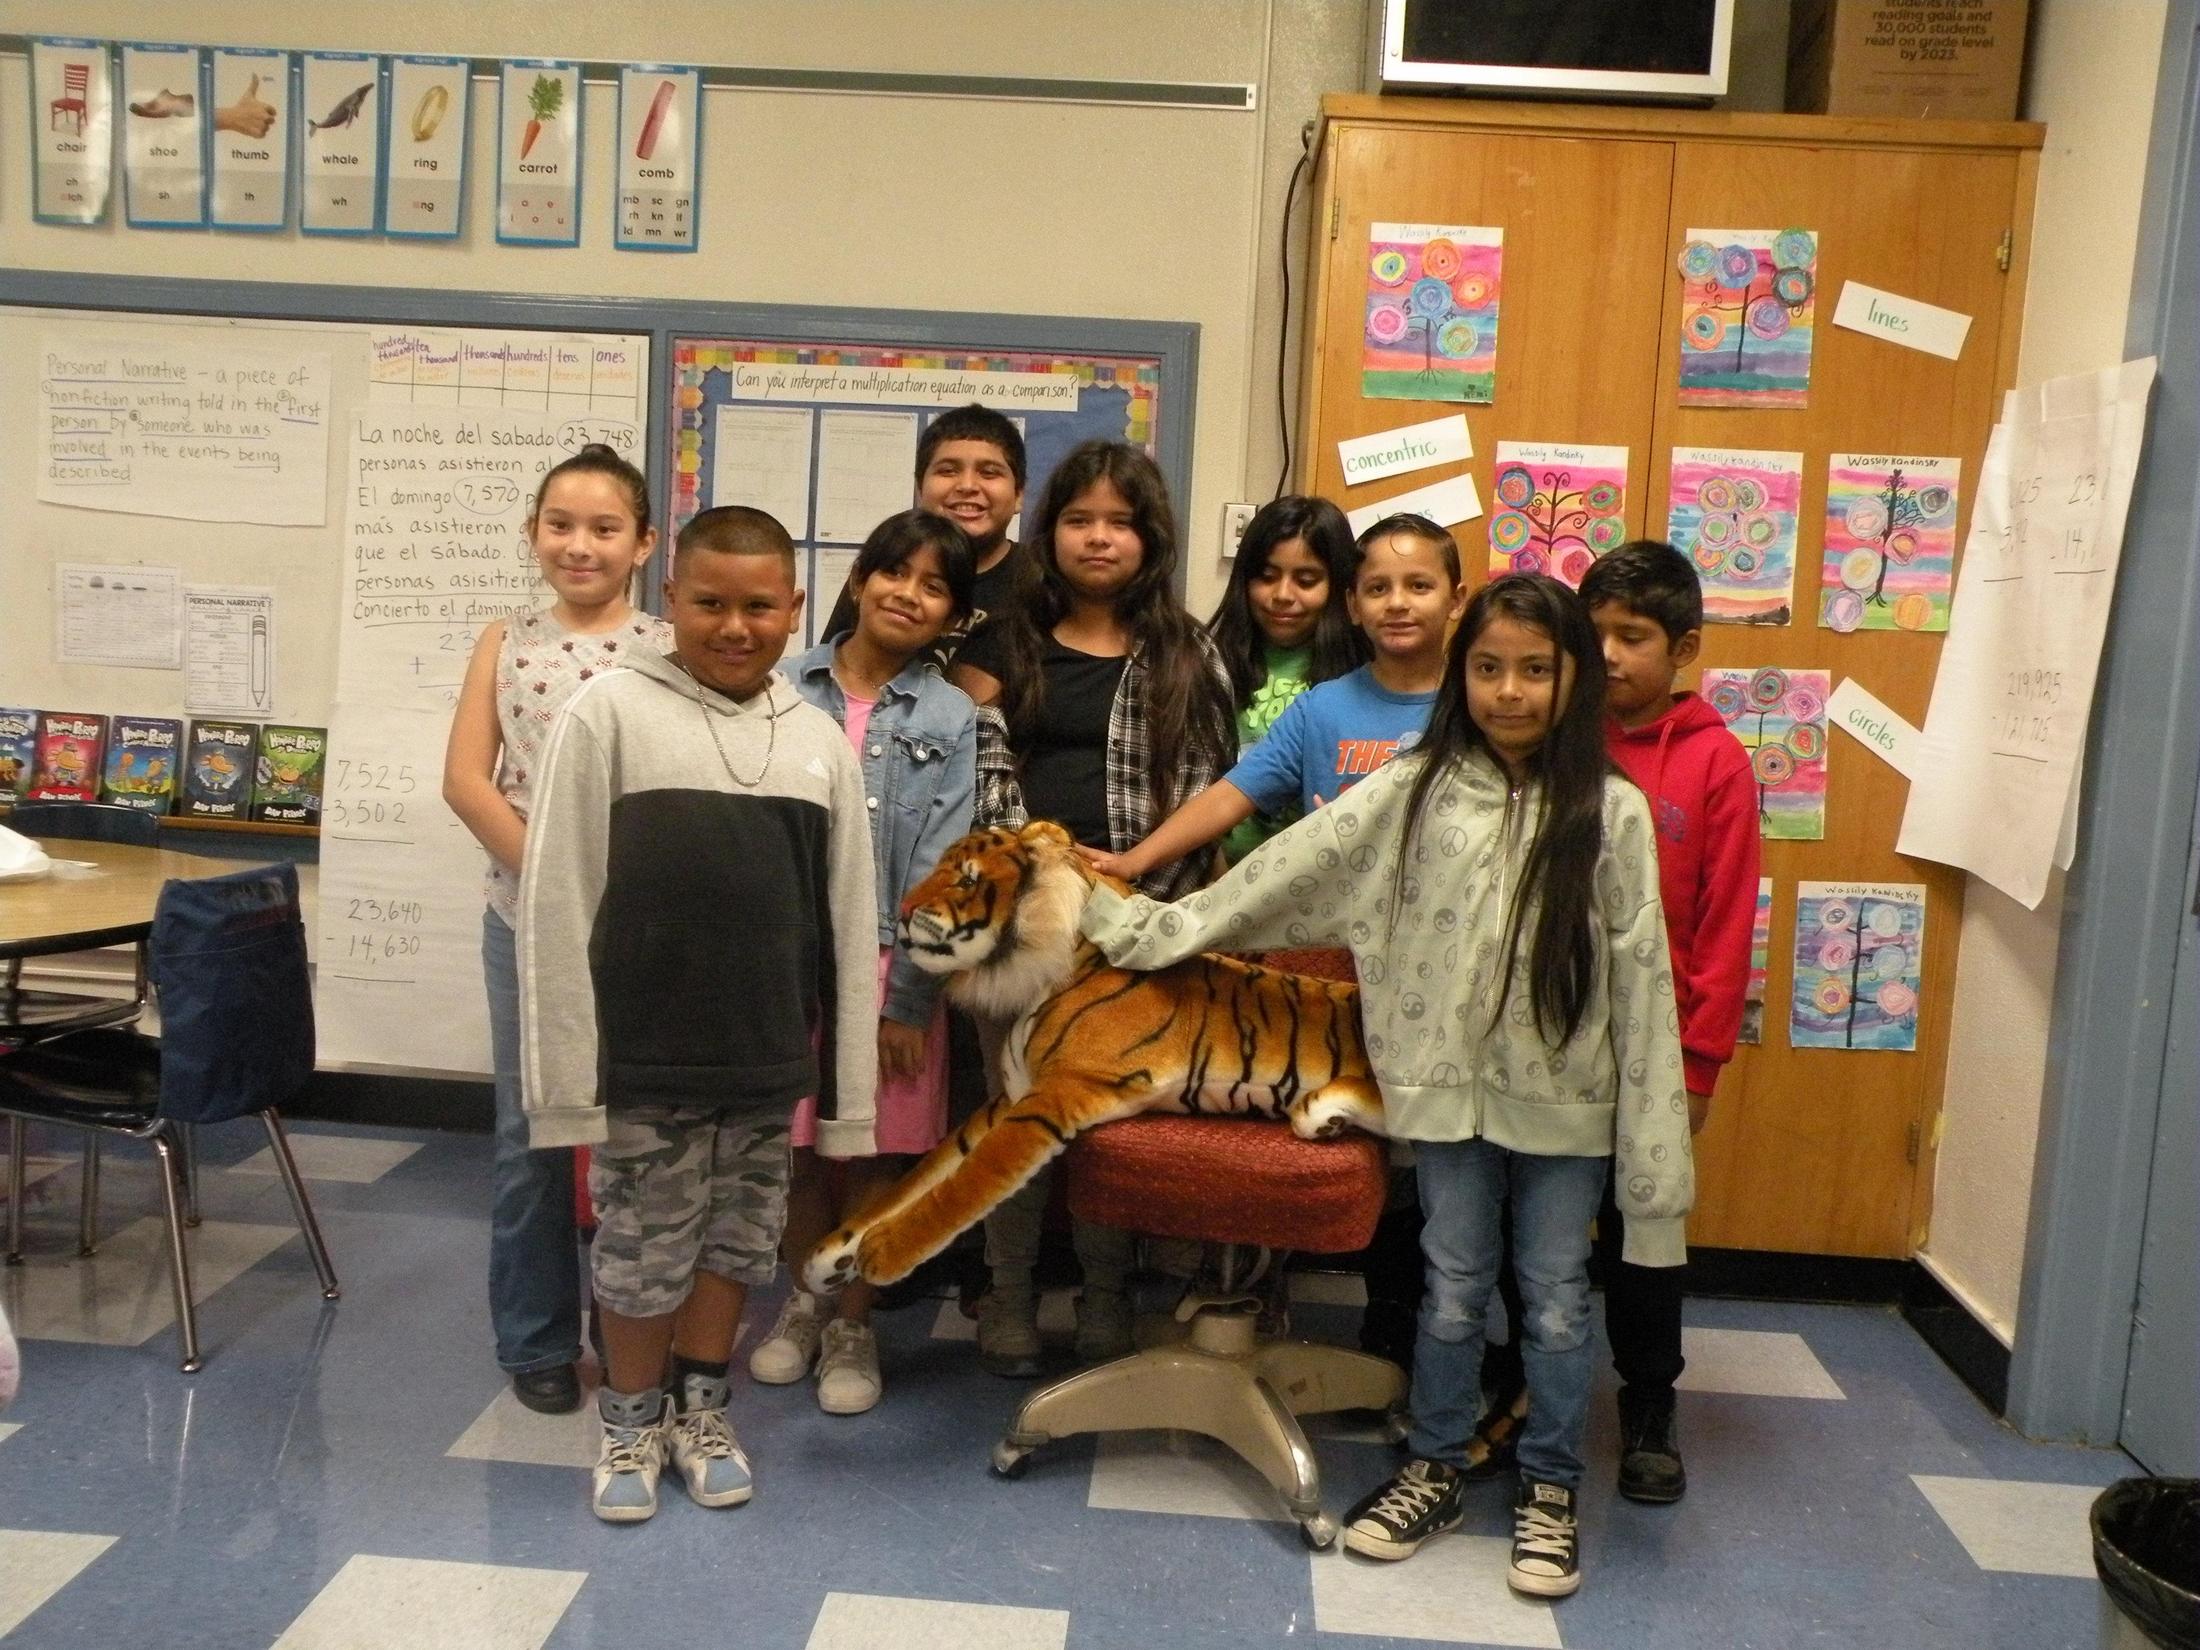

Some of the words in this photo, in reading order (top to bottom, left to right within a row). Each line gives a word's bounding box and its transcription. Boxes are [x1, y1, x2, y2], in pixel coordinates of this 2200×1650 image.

[1873, 9, 1923, 22] reading
[1927, 9, 1962, 23] goals
[1967, 11, 1992, 22] and
[1929, 23, 1986, 35] students
[1865, 35, 1895, 46] read
[1899, 38, 1915, 46] on
[1919, 36, 1958, 49] grade
[1962, 36, 1994, 48] level
[1900, 49, 1917, 61] by
[56, 142, 87, 153] chair
[150, 147, 178, 158] shoe
[231, 149, 270, 160] thumb
[322, 154, 359, 165] whale
[414, 158, 438, 170] ring
[519, 163, 558, 174] carrot
[639, 168, 675, 179] comb
[332, 196, 347, 206] wh
[623, 196, 640, 205] mb
[651, 197, 663, 206] sc
[676, 199, 689, 209] gn
[651, 212, 664, 221] kn
[645, 228, 661, 236] mn
[674, 229, 687, 238] wr
[1867, 297, 1910, 334] lines
[506, 344, 549, 362] hundreds
[557, 348, 580, 363] tens
[595, 350, 626, 364] ones
[47, 353, 106, 376] Personal
[121, 359, 186, 380] Narrative
[236, 370, 277, 393] piece
[288, 366, 310, 386] of
[736, 365, 760, 387] Can
[766, 370, 786, 399] you
[791, 369, 839, 398] interpret
[838, 378, 847, 390] a
[851, 371, 927, 399] multiplication
[930, 375, 977, 401] equation
[981, 384, 994, 396] as
[998, 385, 1006, 396] a
[1012, 374, 1078, 403] comparison?
[137, 391, 190, 420] writing
[197, 391, 224, 411] told
[231, 399, 247, 412] in
[254, 397, 280, 414] the
[288, 397, 321, 418] first
[52, 415, 98, 440] person
[110, 410, 127, 439] by
[137, 419, 195, 433] someone
[203, 420, 232, 434] who
[239, 422, 271, 436] was
[359, 420, 384, 443] La
[392, 424, 444, 445] noche
[456, 423, 482, 444] del
[49, 440, 106, 458] involved
[120, 444, 134, 457] in
[142, 441, 169, 458] the
[179, 443, 230, 459] events
[239, 447, 281, 474] being
[1346, 437, 1438, 473] concentric
[359, 457, 427, 482] personas
[438, 451, 523, 473] asistieron
[358, 486, 377, 507] El
[391, 489, 450, 514] domingo
[464, 484, 519, 507] 7,570
[409, 517, 506, 534] asistieron
[354, 546, 386, 573] que
[400, 543, 417, 560] el
[355, 574, 435, 601] personas
[190, 597, 224, 606] PERSONAL
[440, 598, 456, 616] el
[1335, 739, 1401, 776] THE
[337, 759, 416, 794] 7,525
[333, 799, 407, 828] 3,502
[347, 898, 422, 925] 23,640
[350, 934, 421, 965] 14,630
